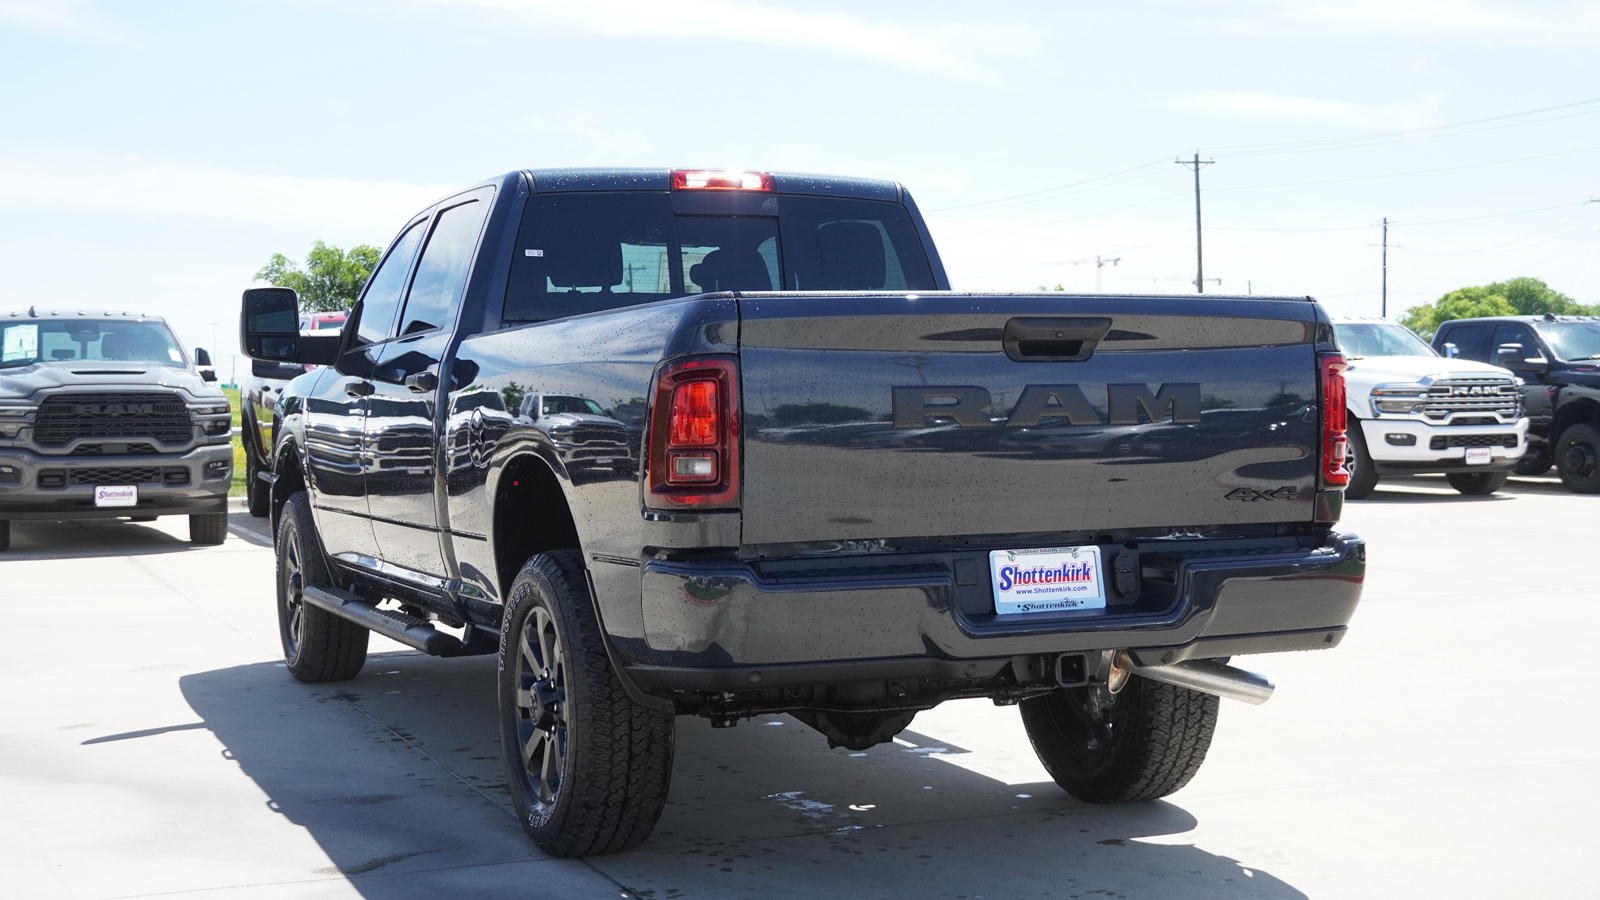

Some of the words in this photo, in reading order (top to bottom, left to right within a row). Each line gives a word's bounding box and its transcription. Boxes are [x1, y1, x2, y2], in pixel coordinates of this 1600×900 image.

[1453, 385, 1498, 395] RAM
[75, 403, 154, 414] RAM
[892, 383, 1201, 428] RAM
[99, 490, 134, 499] Shottenkirk
[999, 562, 1092, 592] Shottenkirk
[1015, 586, 1088, 595] www.Shottenkirk.com
[1021, 600, 1078, 611] Shottenkirk
